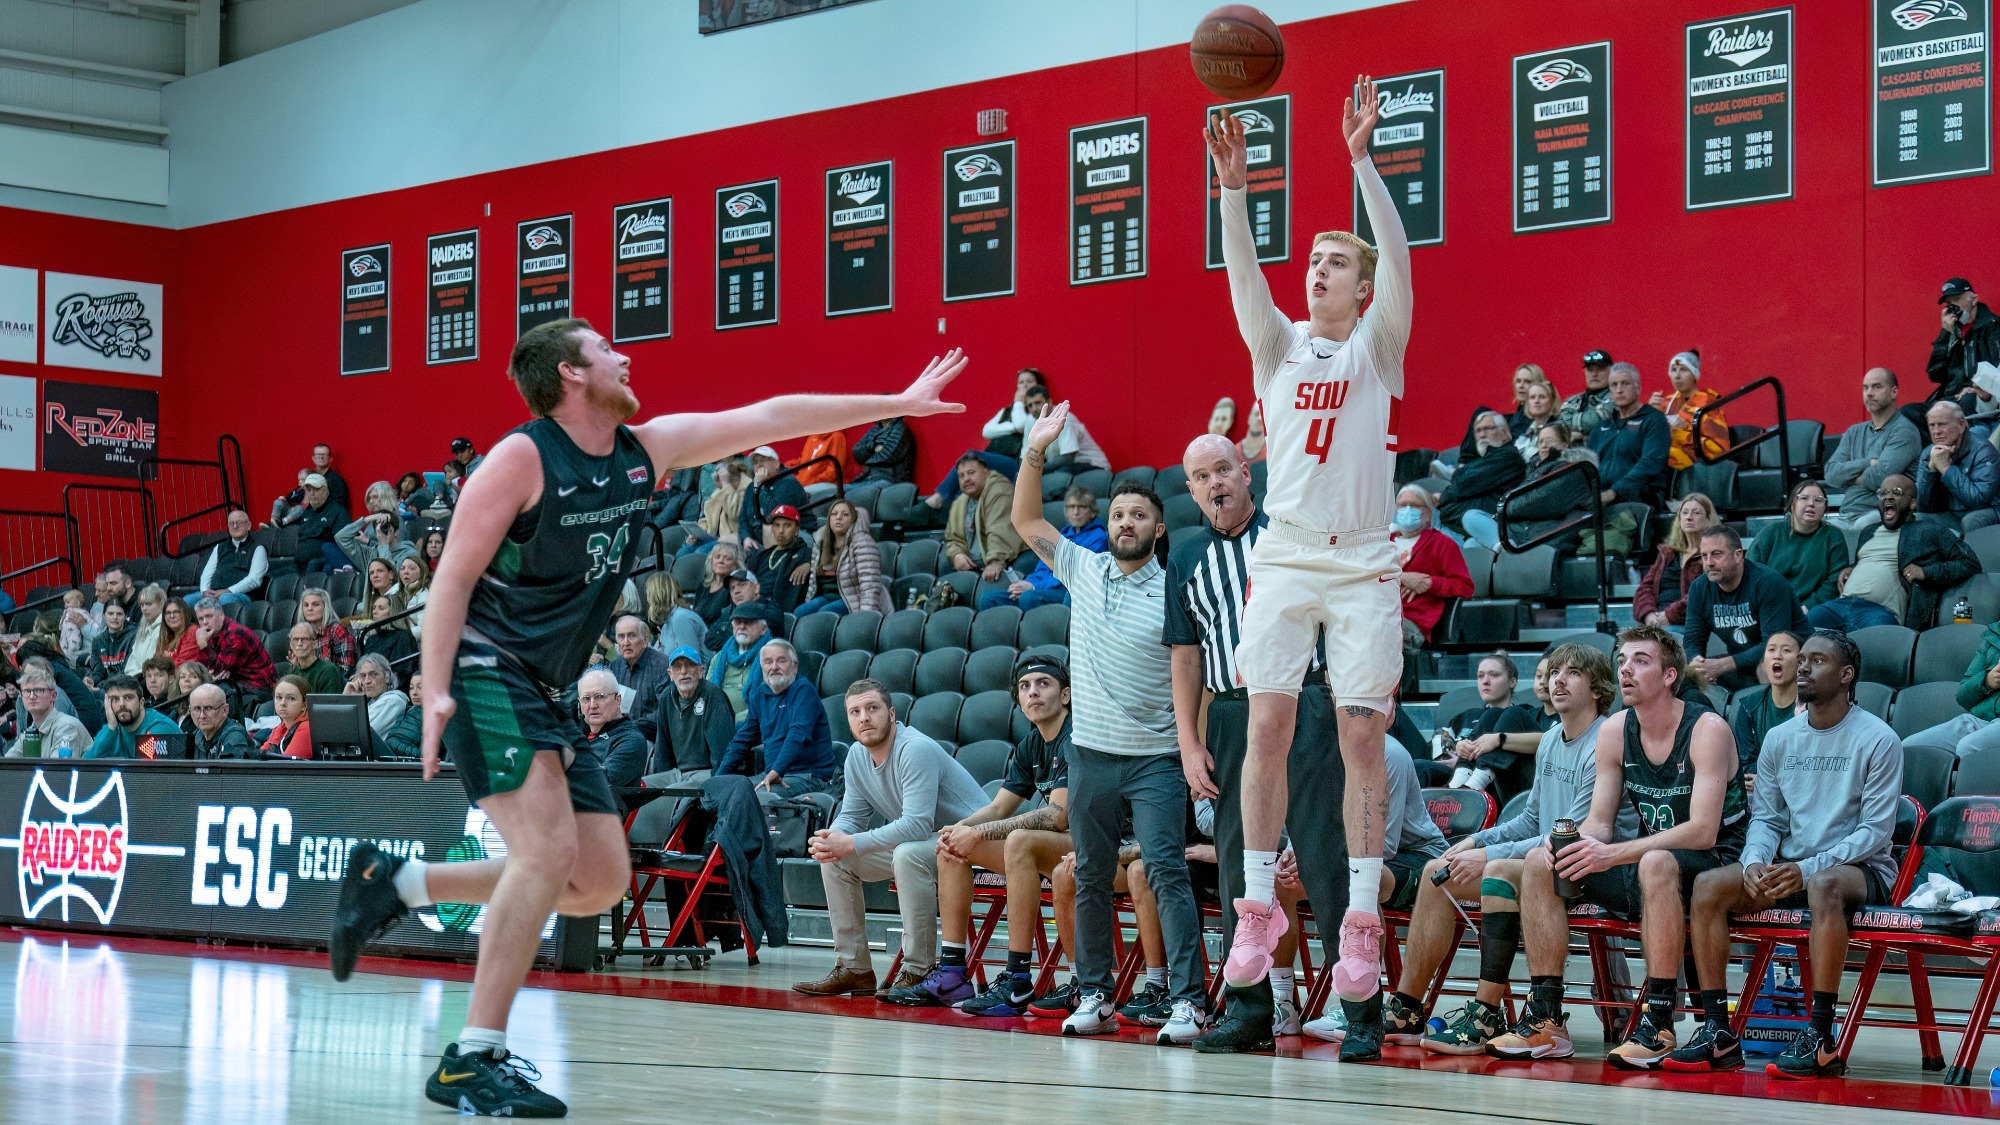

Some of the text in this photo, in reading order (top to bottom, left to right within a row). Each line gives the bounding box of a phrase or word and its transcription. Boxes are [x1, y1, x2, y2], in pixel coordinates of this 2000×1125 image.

[1704, 25, 1773, 57] Raiders
[1881, 36, 1983, 62] WOMEN'S BASKETBALL
[1693, 67, 1786, 92] WOMEN'S BASKETBALL
[1881, 62, 1981, 86] CASCADE CONFERENCE
[1879, 77, 1983, 101] TOURNAMENT CHAMPIONS
[1378, 84, 1434, 118] Raiders
[1540, 100, 1584, 117] VOLLEYBALL
[1693, 92, 1785, 115] CASCADE CONFERENCE
[1714, 110, 1762, 126] CHAMPIONS
[1379, 126, 1419, 141] VOLLEYBALL
[1077, 133, 1139, 165] RAIDERS
[837, 171, 881, 196] Raiders
[1091, 169, 1125, 182] VOLLEYBALL
[964, 189, 996, 203] VOLLEYBALL
[852, 207, 882, 220] WRESTLING
[620, 208, 666, 244] Raiders
[741, 225, 768, 236] WRESTLING
[432, 242, 474, 267] RAIDERS
[539, 257, 564, 268] WRESTLING
[93, 293, 135, 305] MEDFORD
[54, 294, 143, 350] Rogues
[1295, 380, 1349, 410] SOU
[88, 438, 151, 450] SPORTS BAR
[1305, 417, 1336, 464] 4
[105, 453, 135, 463] GRILL
[1428, 800, 1462, 814] Flagship
[1435, 814, 1448, 827] Inn
[1973, 824, 1990, 838] Inn
[21, 825, 124, 882] RAIDERS
[192, 805, 292, 909] ESC
[1853, 912, 1923, 929] RAIDERS
